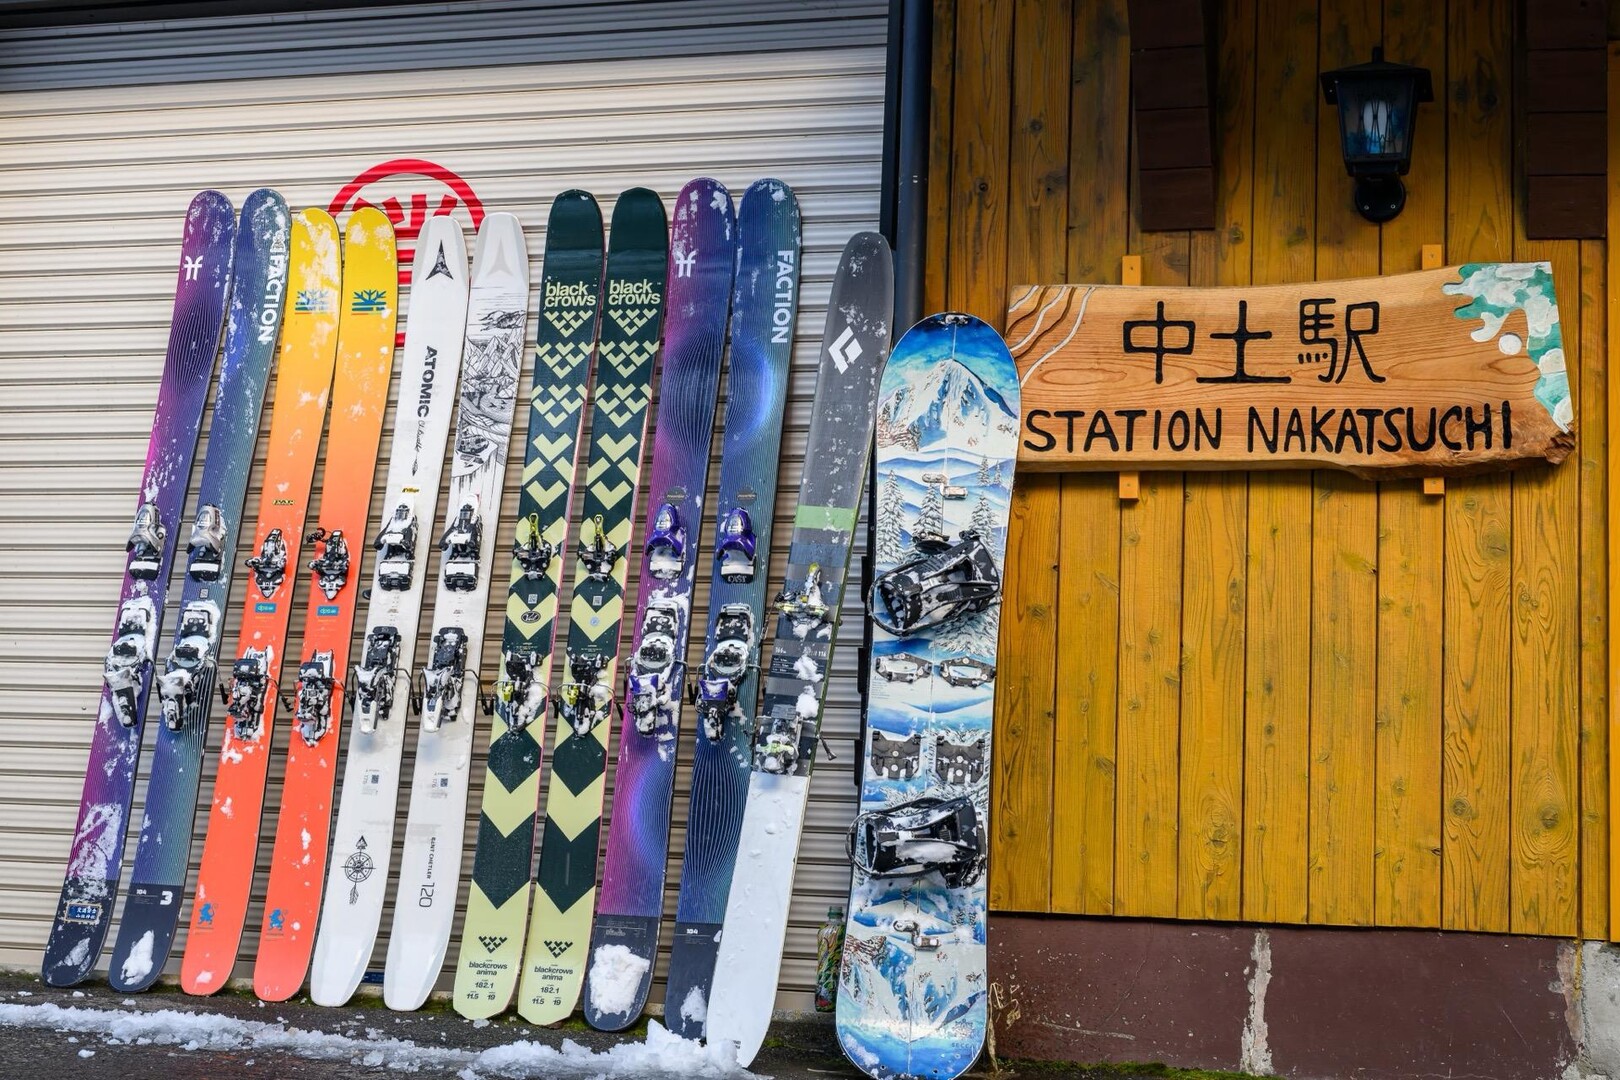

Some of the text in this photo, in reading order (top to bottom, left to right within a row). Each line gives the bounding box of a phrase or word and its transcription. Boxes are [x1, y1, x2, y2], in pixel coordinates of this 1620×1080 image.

[545, 281, 589, 296] black
[609, 278, 653, 294] black
[258, 254, 287, 343] FACTION
[544, 294, 597, 308] crows
[608, 292, 661, 306] crows
[771, 248, 795, 345] FACTION
[1122, 297, 1386, 384] 中土駅
[417, 345, 438, 418] ATOMIC
[1023, 400, 1513, 455] STATION NAKATSUCHI
[160, 890, 174, 906] 3
[419, 882, 436, 908] 120
[468, 961, 508, 970] blackcrows
[476, 968, 498, 976] anima
[534, 966, 574, 975] blackcrows
[475, 981, 495, 989] 182.1
[540, 986, 560, 994] 182.1
